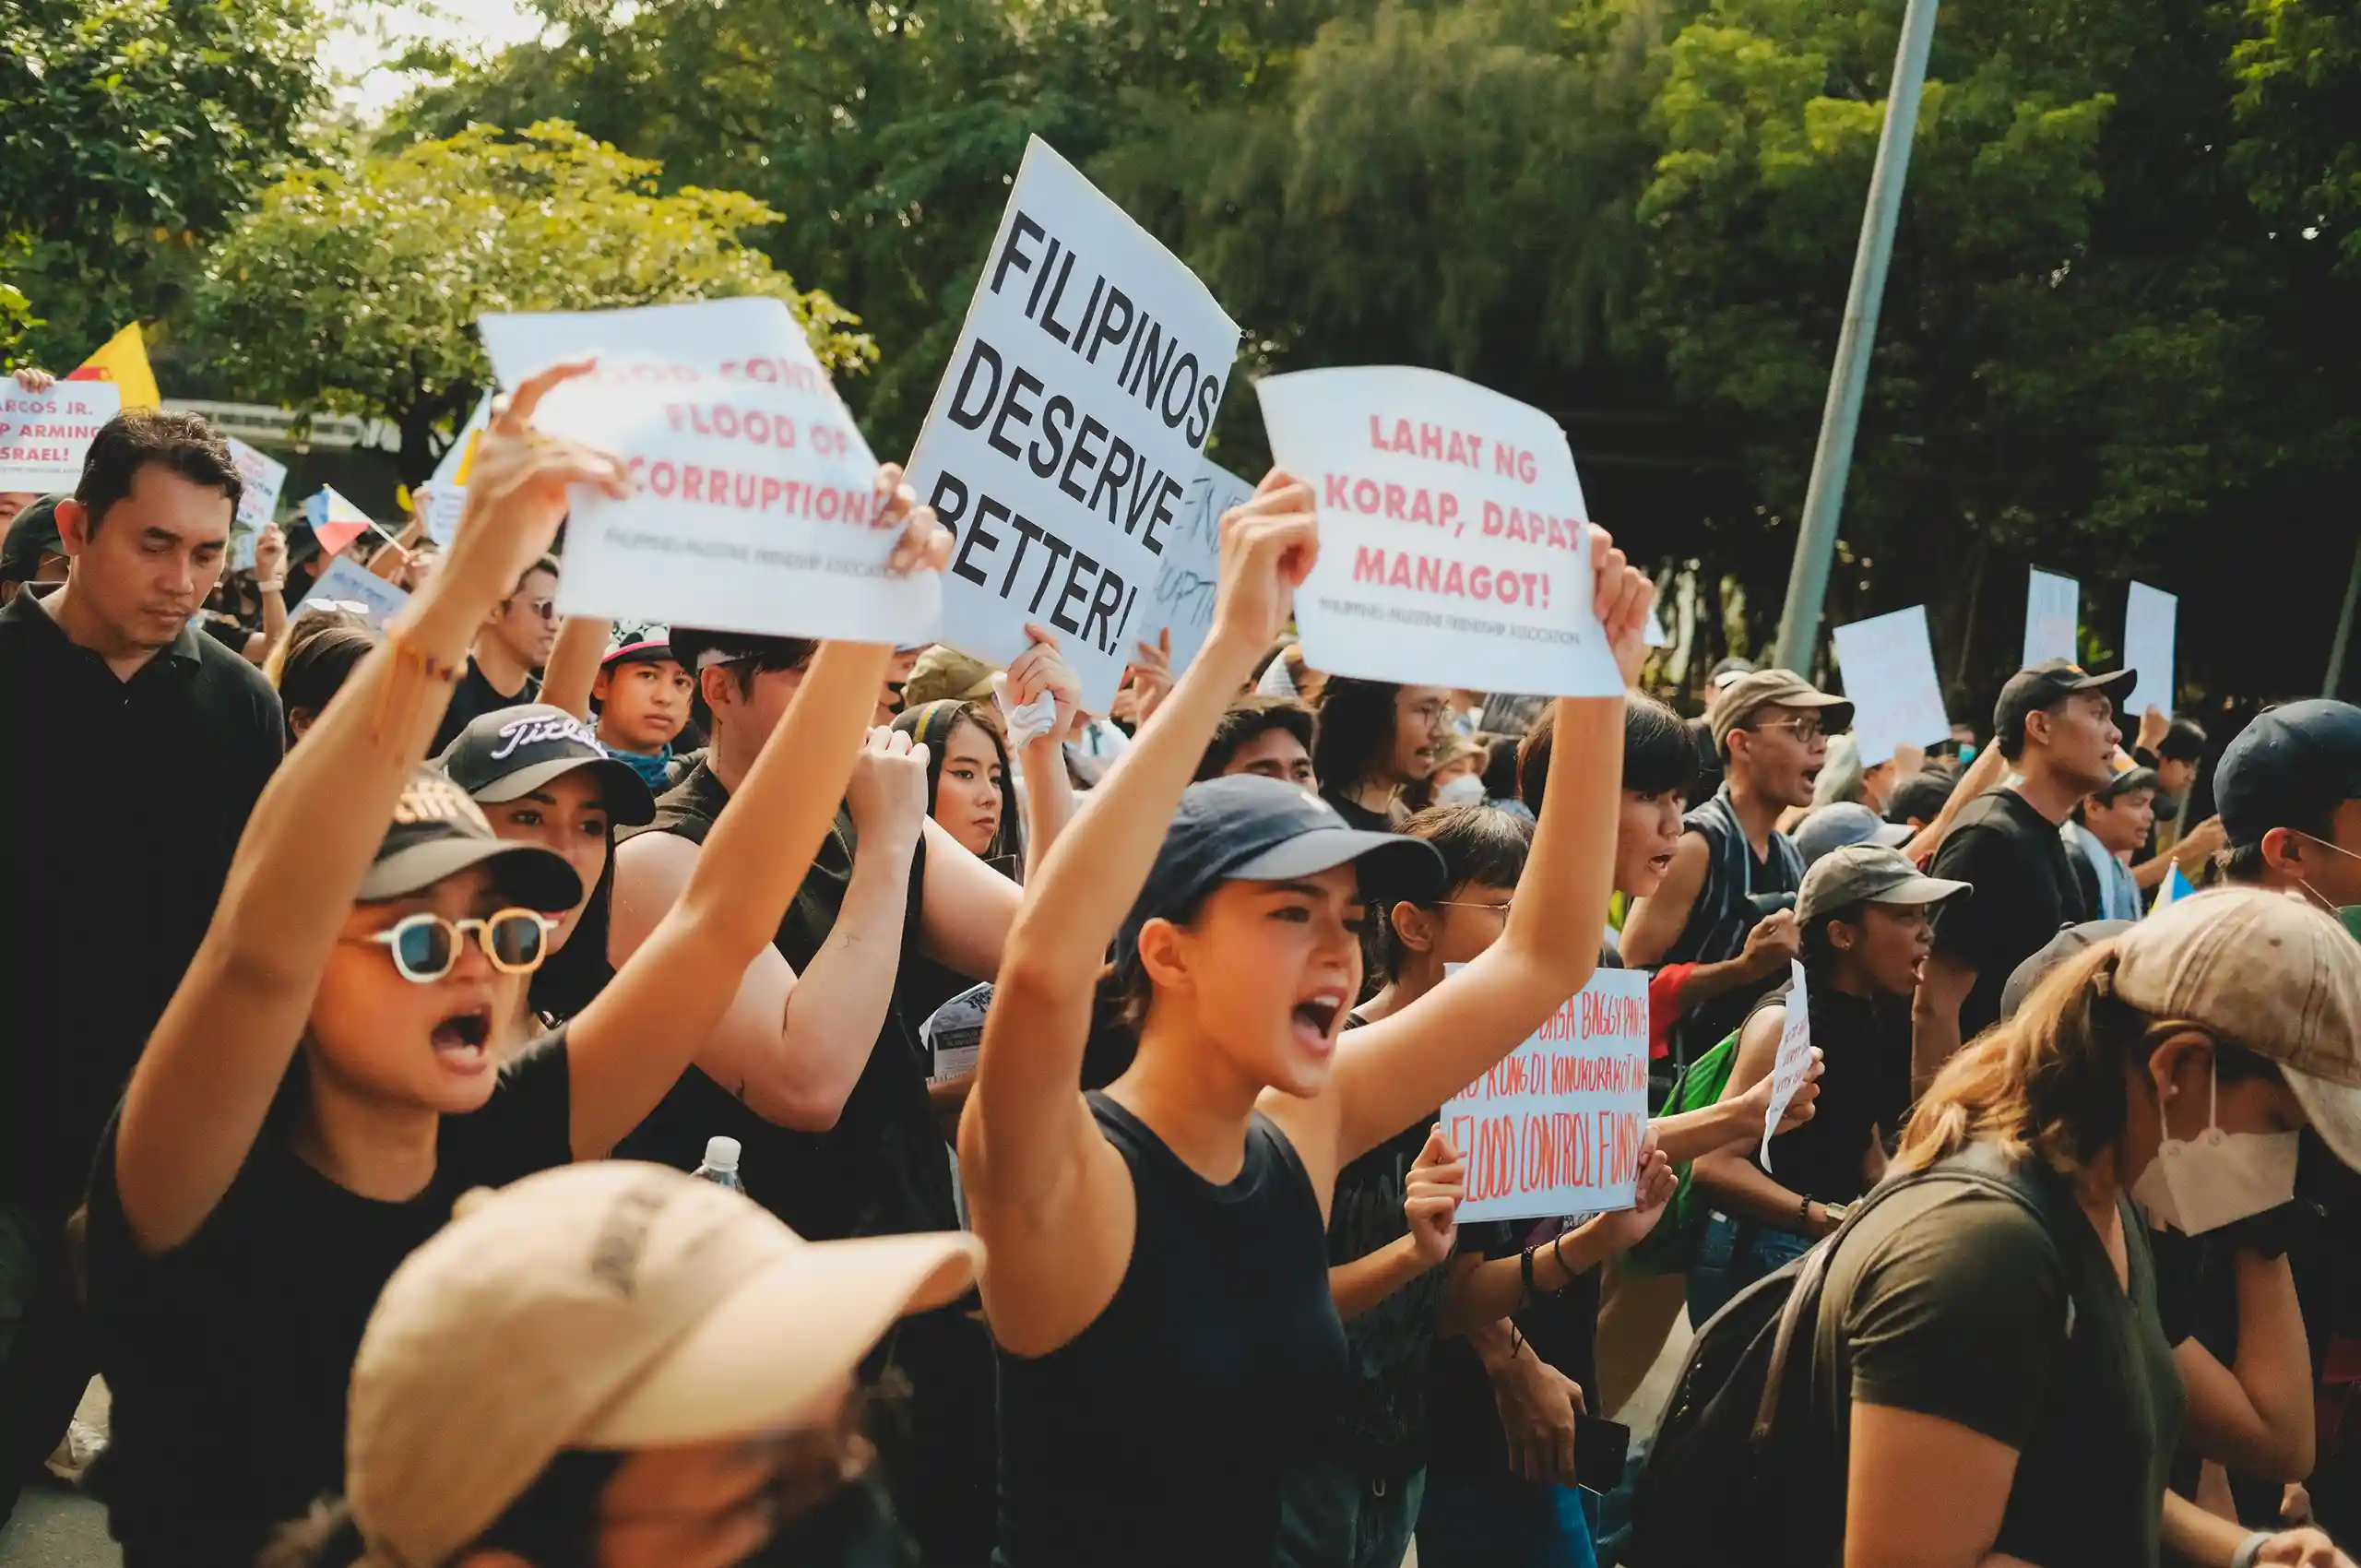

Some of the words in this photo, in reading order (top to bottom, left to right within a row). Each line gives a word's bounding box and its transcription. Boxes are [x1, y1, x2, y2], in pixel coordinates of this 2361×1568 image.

[991, 209, 1218, 449] FILIPINOS
[66, 400, 93, 415] JR.
[948, 338, 1183, 556] DESERVE
[1370, 414, 1482, 469] LAHAT
[1495, 443, 1537, 484] NG
[1324, 473, 1465, 539] KORAP,
[1482, 501, 1581, 552] DAPAT
[929, 470, 1138, 657] BETTER!
[1353, 545, 1550, 609] MANAGOT!
[1582, 991, 1622, 1040] BAGGY
[1624, 995, 1646, 1039] PANTS
[1487, 1054, 1528, 1100] KUNG
[1531, 1051, 1546, 1096] DI
[1632, 1055, 1646, 1094] ANG
[1520, 1112, 1594, 1193] CONTROL
